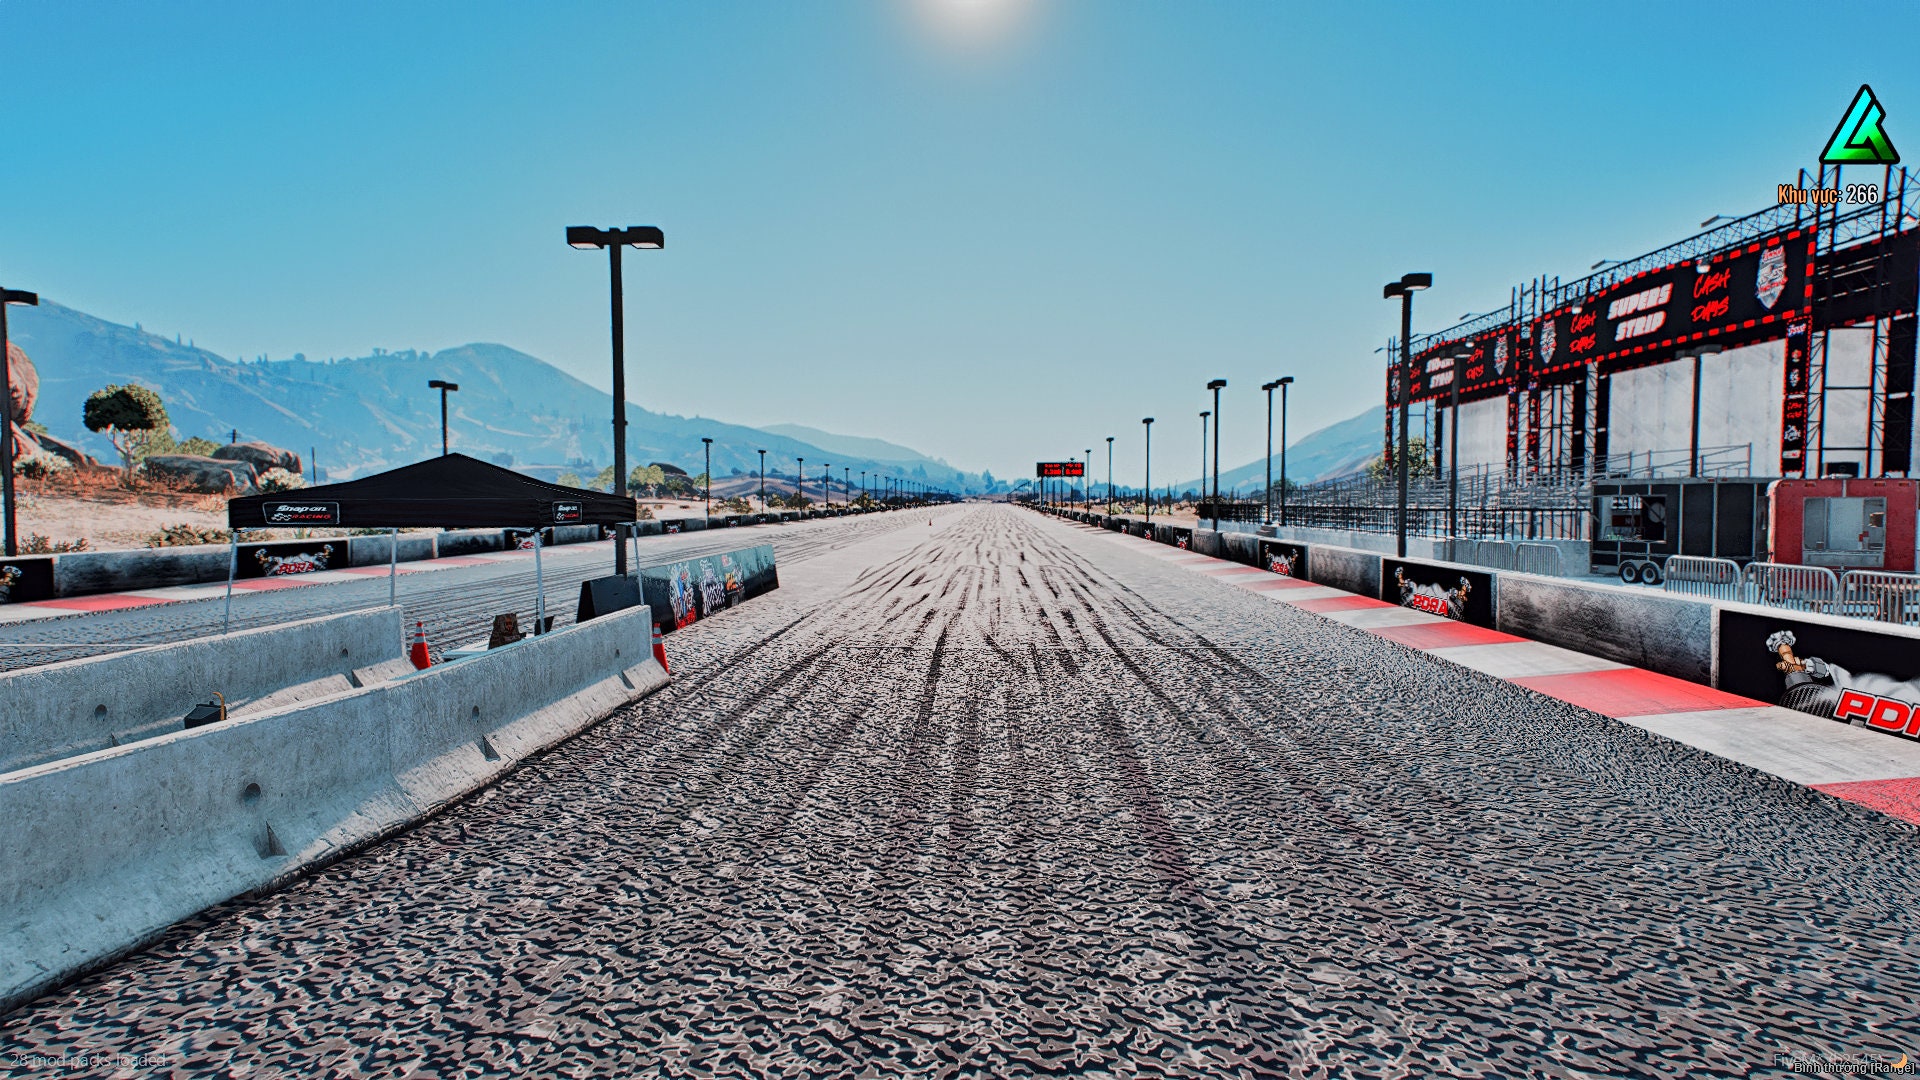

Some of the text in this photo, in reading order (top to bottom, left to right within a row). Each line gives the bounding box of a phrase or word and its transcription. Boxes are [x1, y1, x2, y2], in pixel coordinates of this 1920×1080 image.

[1693, 267, 1731, 299] CASH
[1615, 310, 1667, 342] STRIP
[1412, 593, 1449, 617] PDRA
